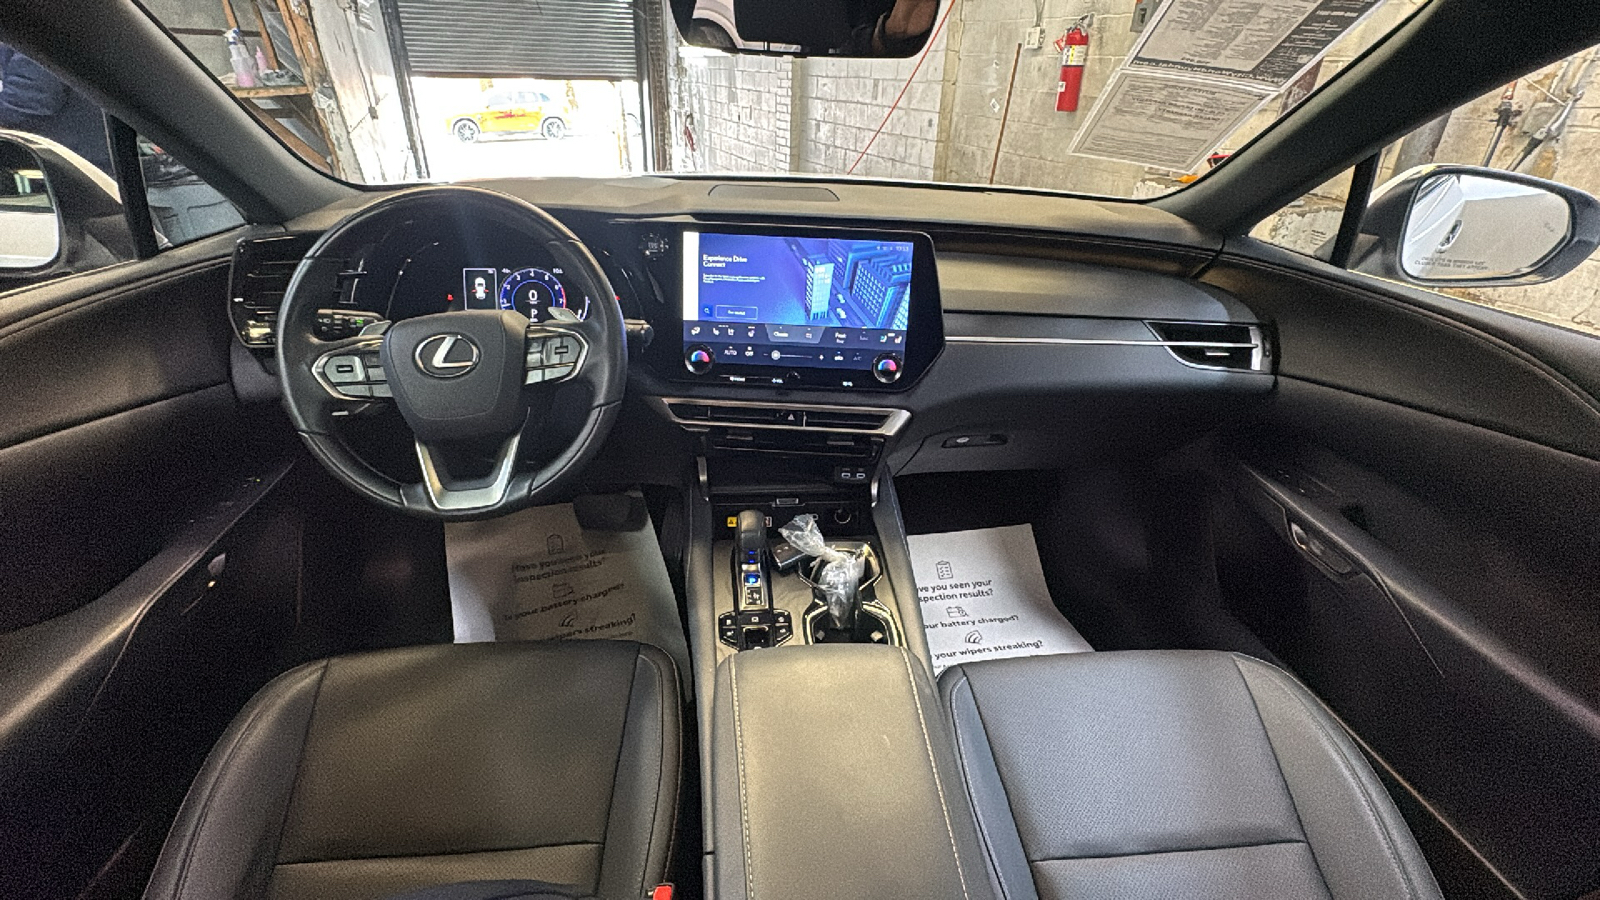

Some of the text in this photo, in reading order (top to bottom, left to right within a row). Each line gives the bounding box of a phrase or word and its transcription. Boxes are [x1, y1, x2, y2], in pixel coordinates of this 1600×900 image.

[702, 254, 732, 263] Experience
[531, 309, 538, 318] P
[930, 585, 948, 594] you
[949, 582, 970, 590] seen
[971, 580, 992, 590] your
[918, 588, 994, 603] spection results?
[940, 619, 976, 628] battery
[977, 614, 1019, 625] charged?
[934, 640, 1043, 660] your wipers streaking?
